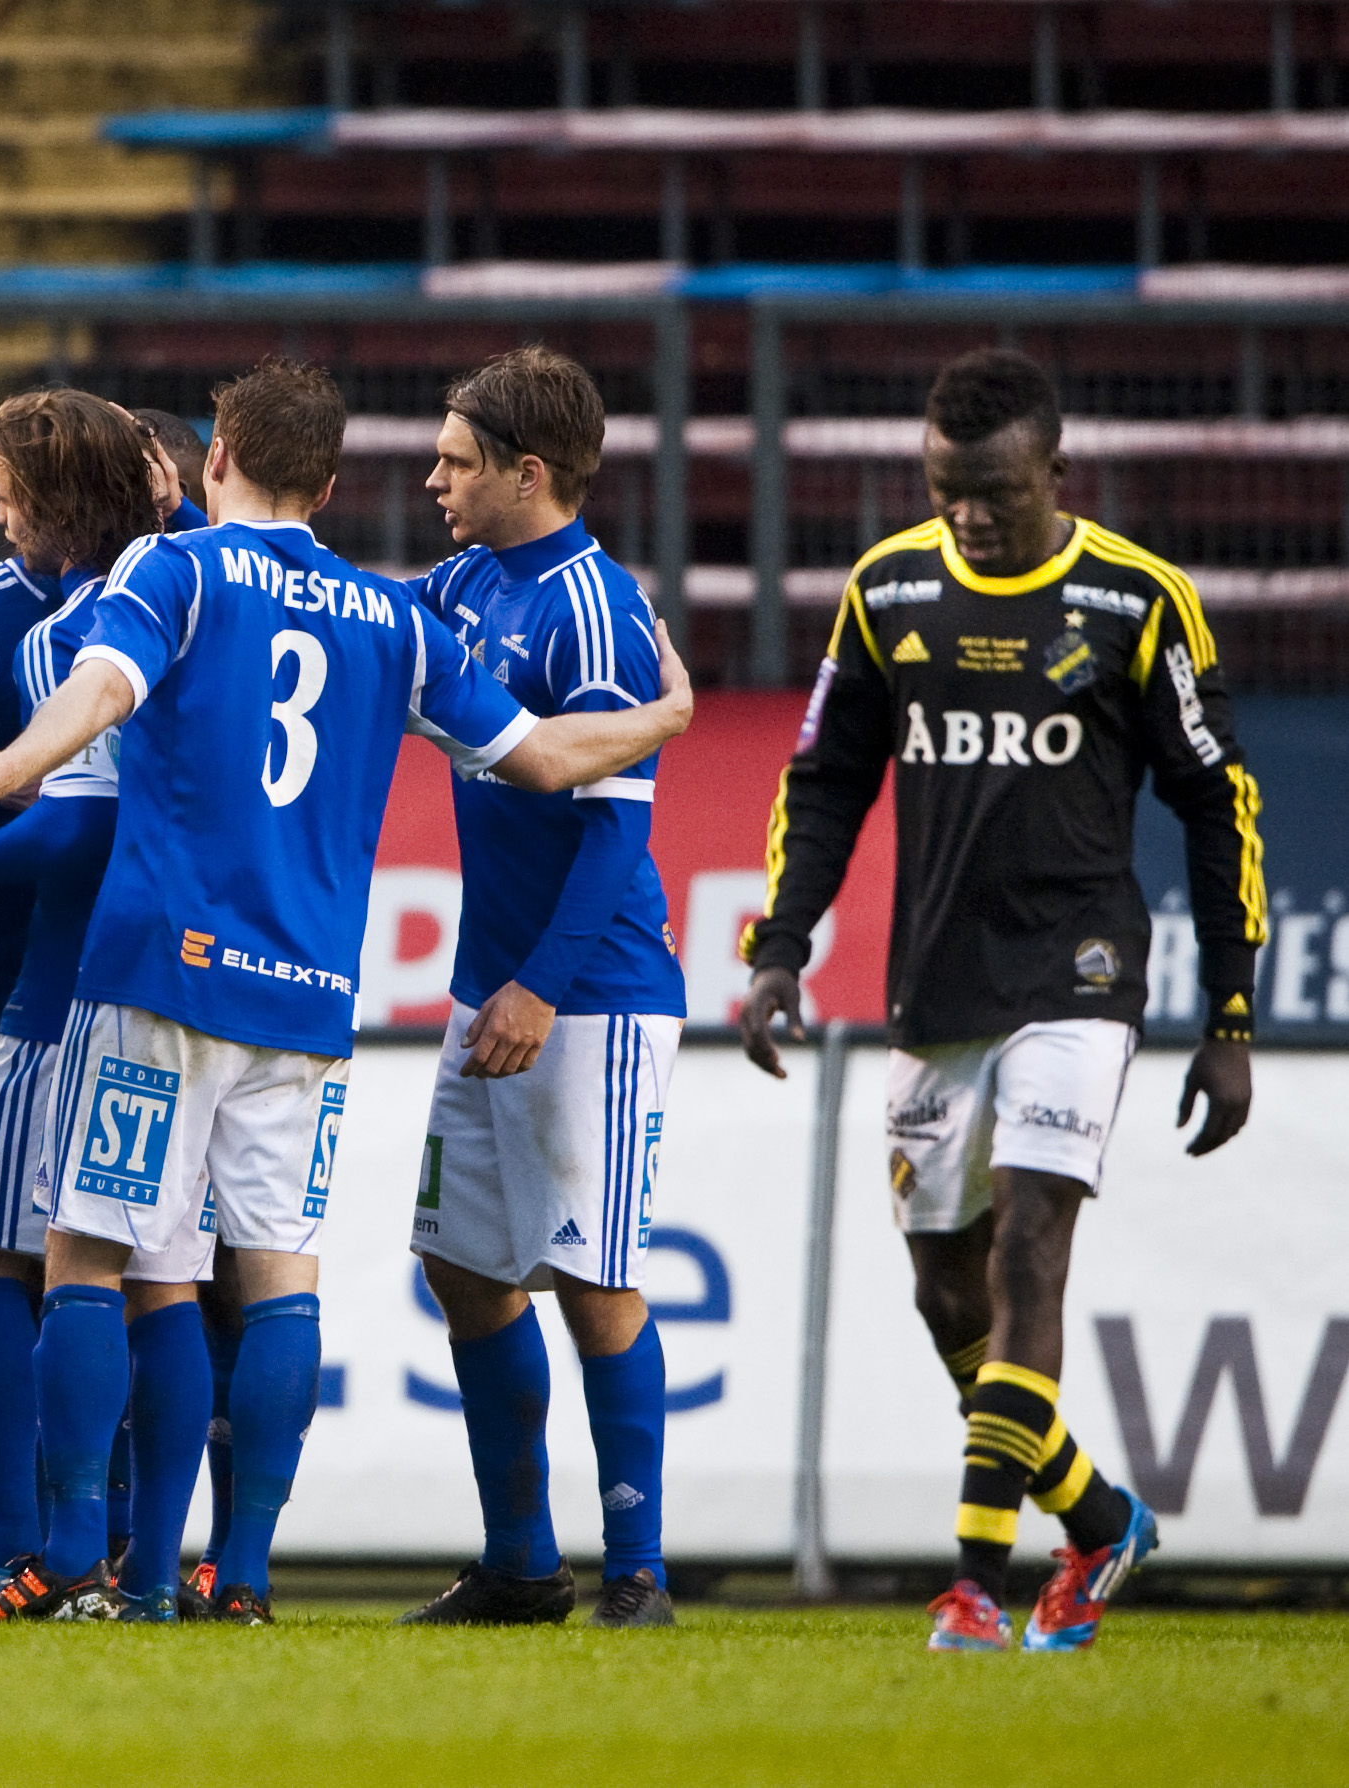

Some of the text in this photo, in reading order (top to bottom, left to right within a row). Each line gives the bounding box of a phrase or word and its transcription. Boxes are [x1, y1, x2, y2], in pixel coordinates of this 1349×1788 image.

[260, 629, 328, 808] 3
[901, 702, 1083, 766] ÅBRO
[105, 1062, 174, 1088] MEDIE
[89, 1088, 169, 1173] ST
[81, 1175, 153, 1200] HUSET
[550, 1235, 588, 1246] adidas
